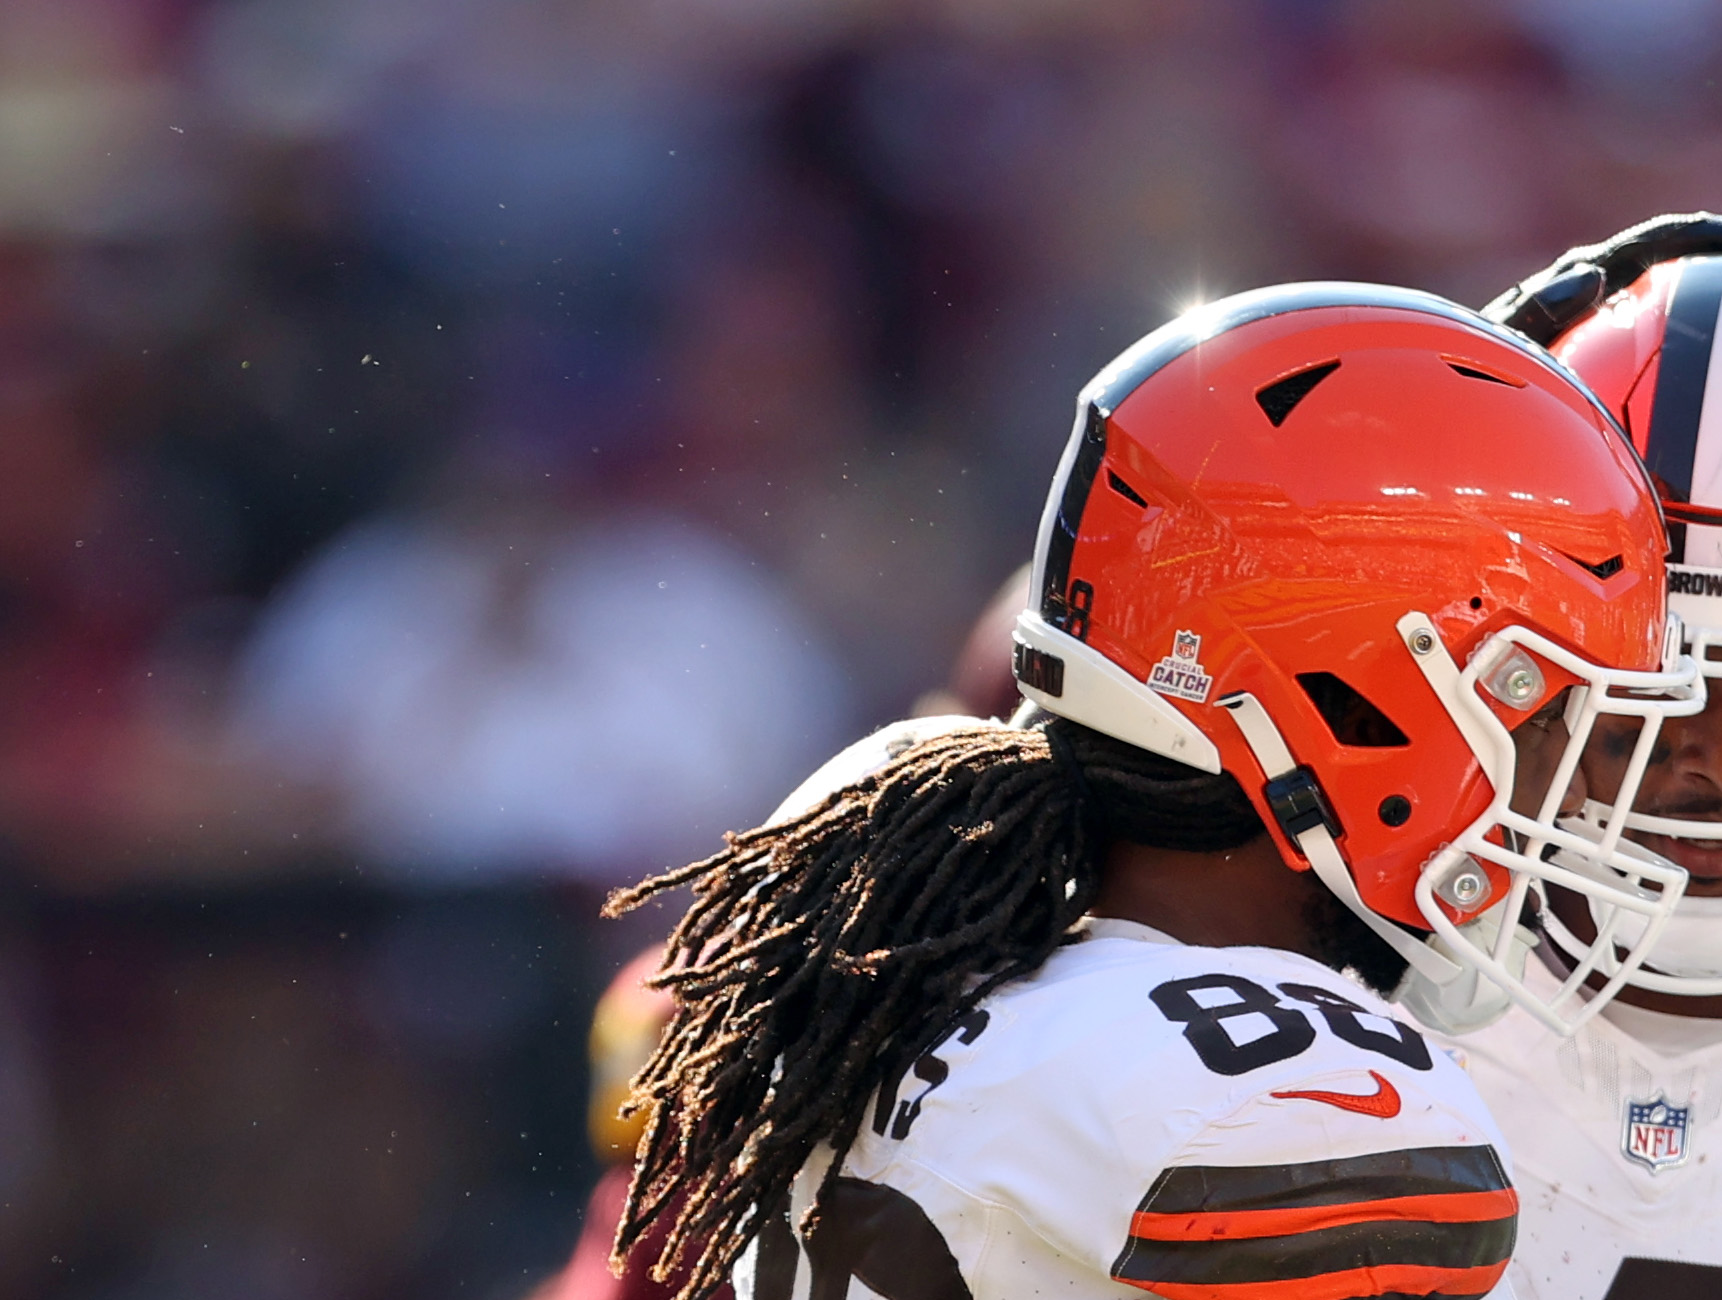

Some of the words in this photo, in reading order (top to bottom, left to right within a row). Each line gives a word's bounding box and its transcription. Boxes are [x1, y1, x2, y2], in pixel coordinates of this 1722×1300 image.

[1152, 666, 1209, 694] CATCH
[1163, 658, 1202, 675] CRUCIAL
[1148, 973, 1433, 1076] 88
[1632, 1125, 1679, 1158] NFL
